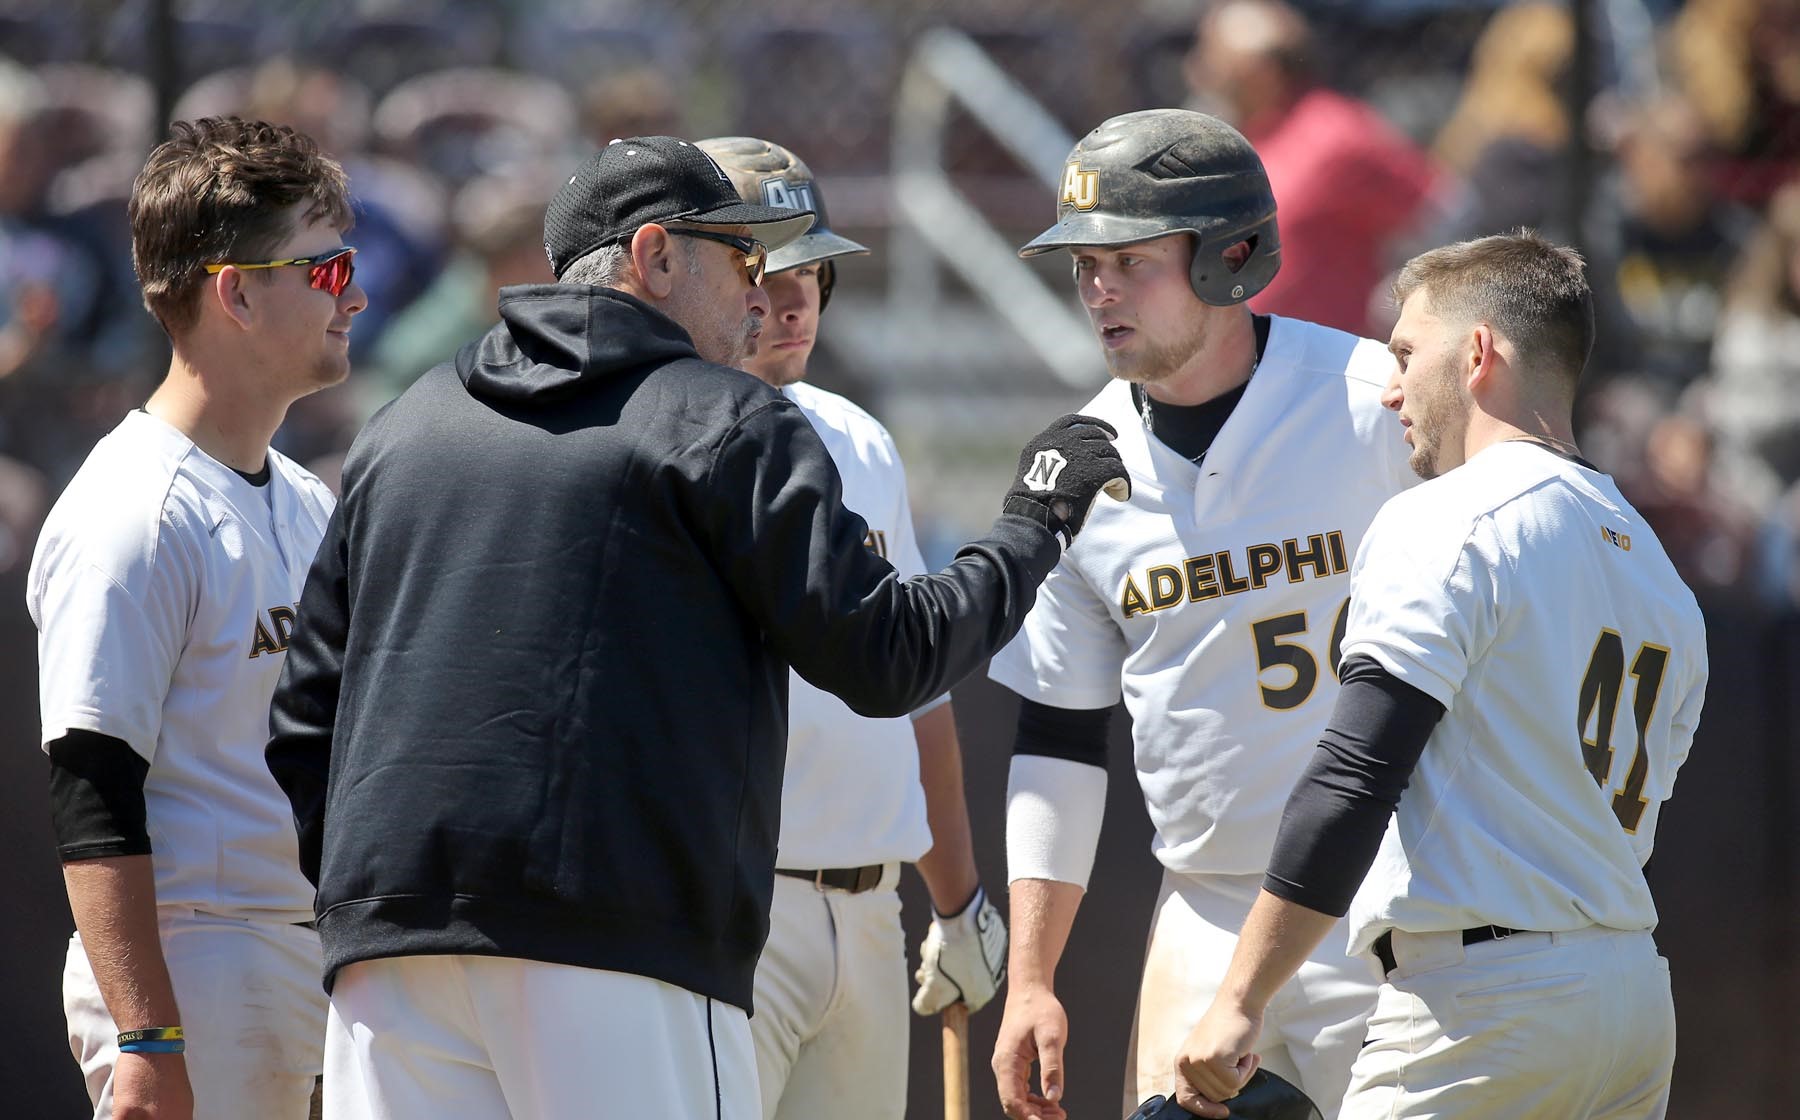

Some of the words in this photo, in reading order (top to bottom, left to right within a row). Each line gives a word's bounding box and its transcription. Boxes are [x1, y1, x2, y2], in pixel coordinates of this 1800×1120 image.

[761, 177, 813, 210] AU
[1061, 161, 1099, 210] AU
[1029, 454, 1061, 486] N
[1121, 530, 1349, 619] ADELPHI
[1576, 626, 1671, 836] 41
